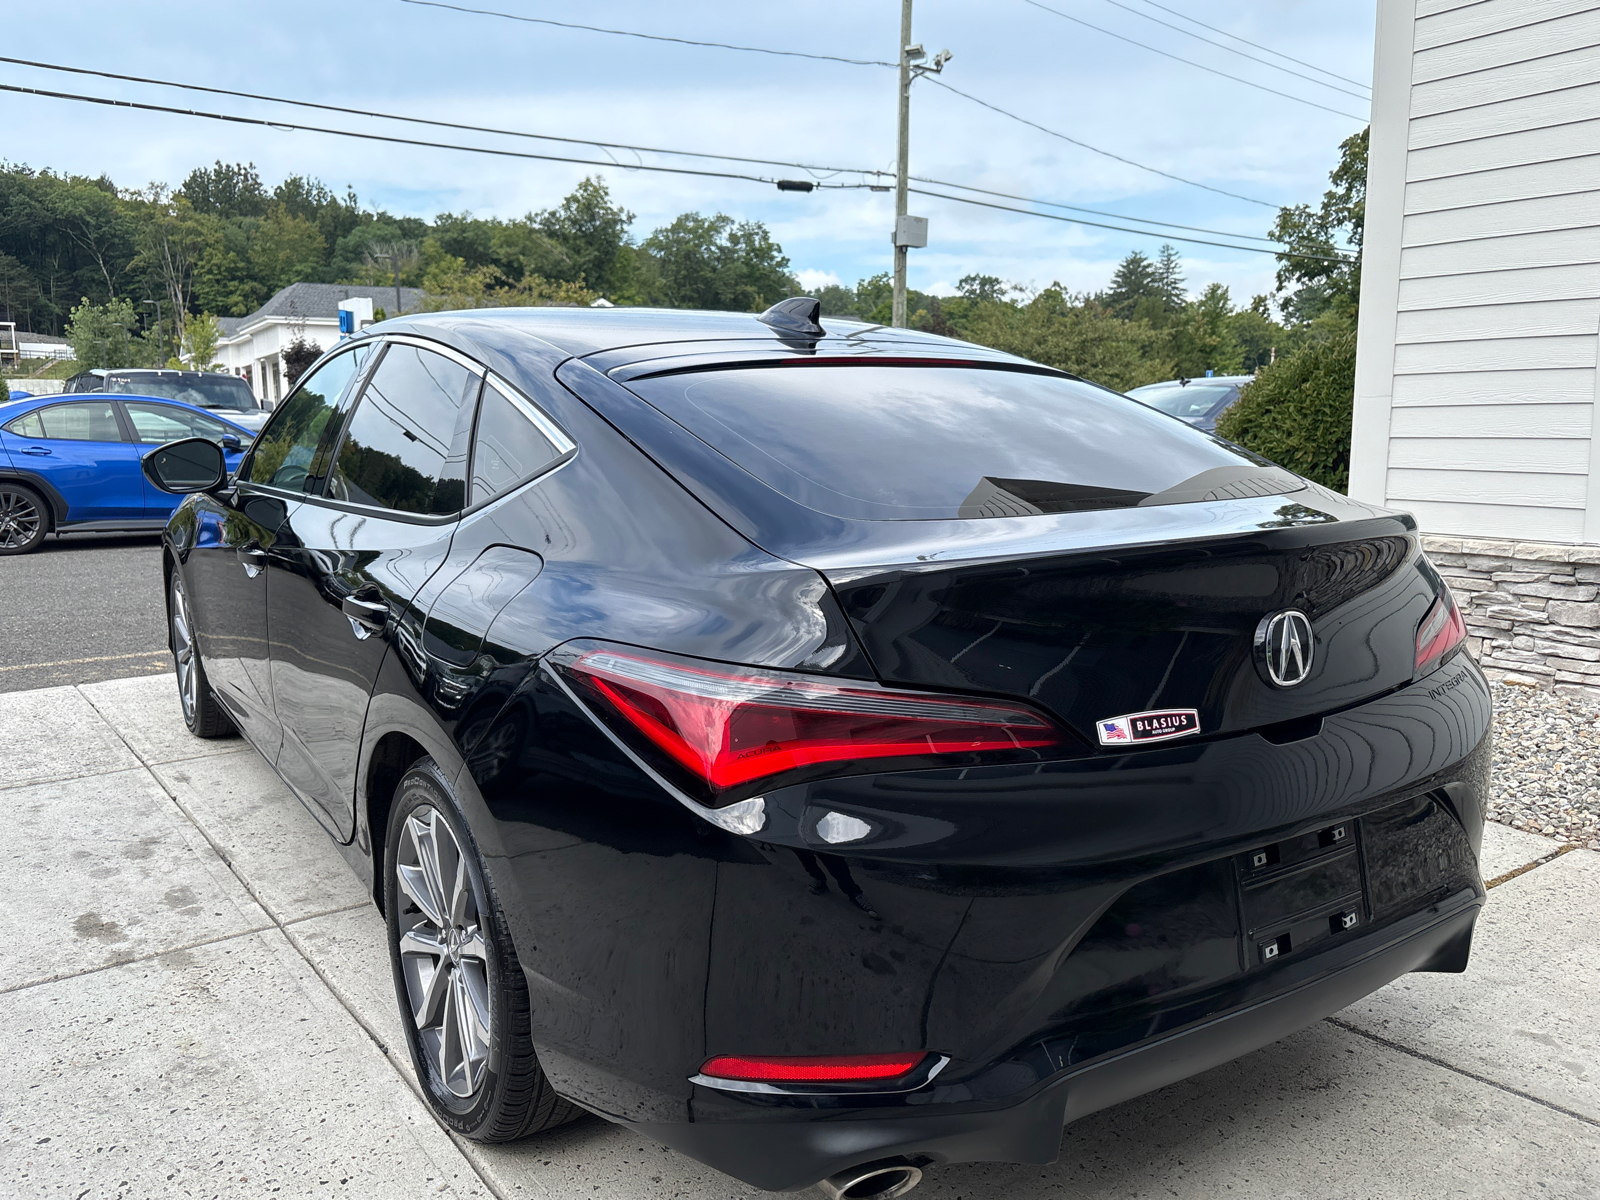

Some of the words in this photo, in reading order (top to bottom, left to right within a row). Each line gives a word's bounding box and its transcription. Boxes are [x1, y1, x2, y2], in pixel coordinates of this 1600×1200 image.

[1428, 670, 1469, 700] INTEGRA
[1136, 715, 1187, 731] BLASIUS
[736, 745, 782, 760] ACURA
